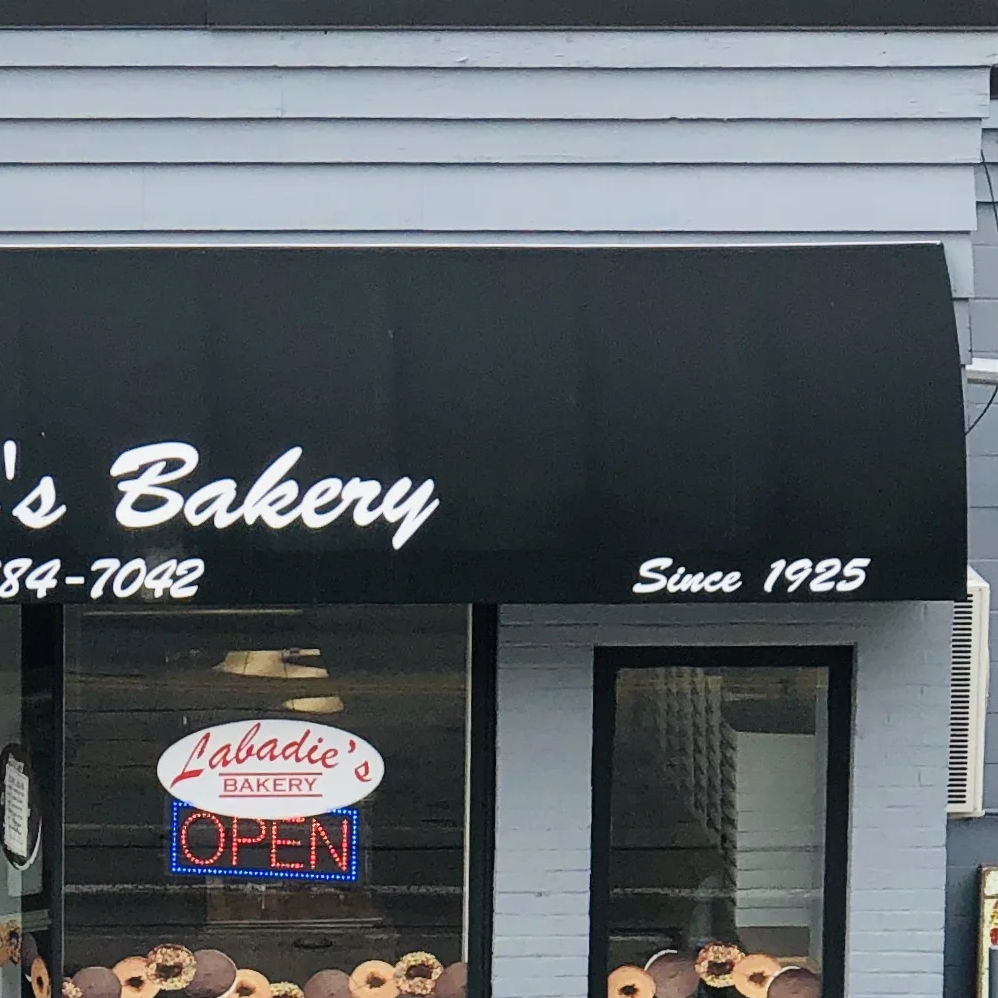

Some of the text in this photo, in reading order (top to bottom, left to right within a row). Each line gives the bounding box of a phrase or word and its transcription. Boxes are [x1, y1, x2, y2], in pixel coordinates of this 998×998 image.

[109, 442, 440, 550] Bakery
[632, 557, 871, 593] Since 1925
[170, 722, 373, 789] Labadie's
[223, 778, 317, 793] BAKERY
[179, 811, 349, 872] OPEN
